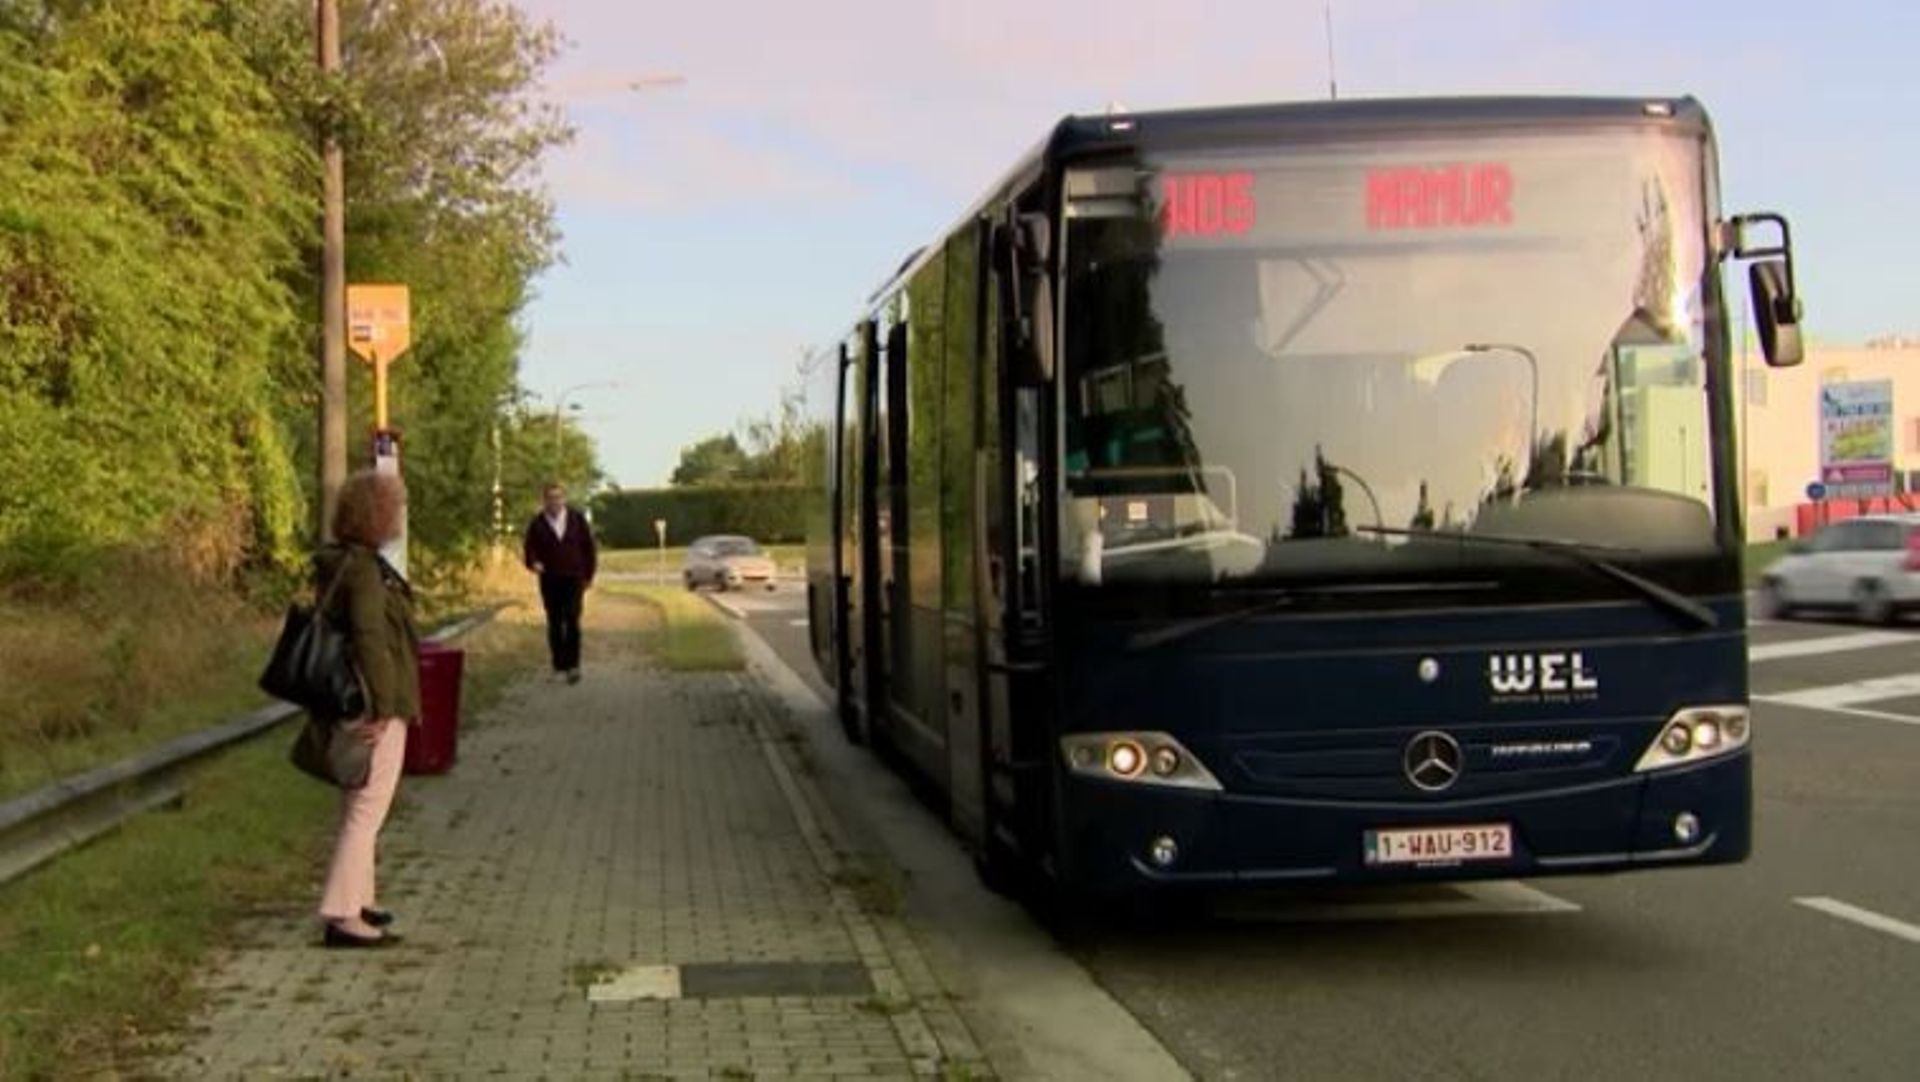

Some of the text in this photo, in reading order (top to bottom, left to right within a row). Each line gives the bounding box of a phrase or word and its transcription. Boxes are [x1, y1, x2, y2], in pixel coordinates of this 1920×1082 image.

[1365, 162, 1513, 229] NAMUR
[1490, 652, 1598, 692] WEL
[1381, 831, 1507, 857] 1-WAU-912
